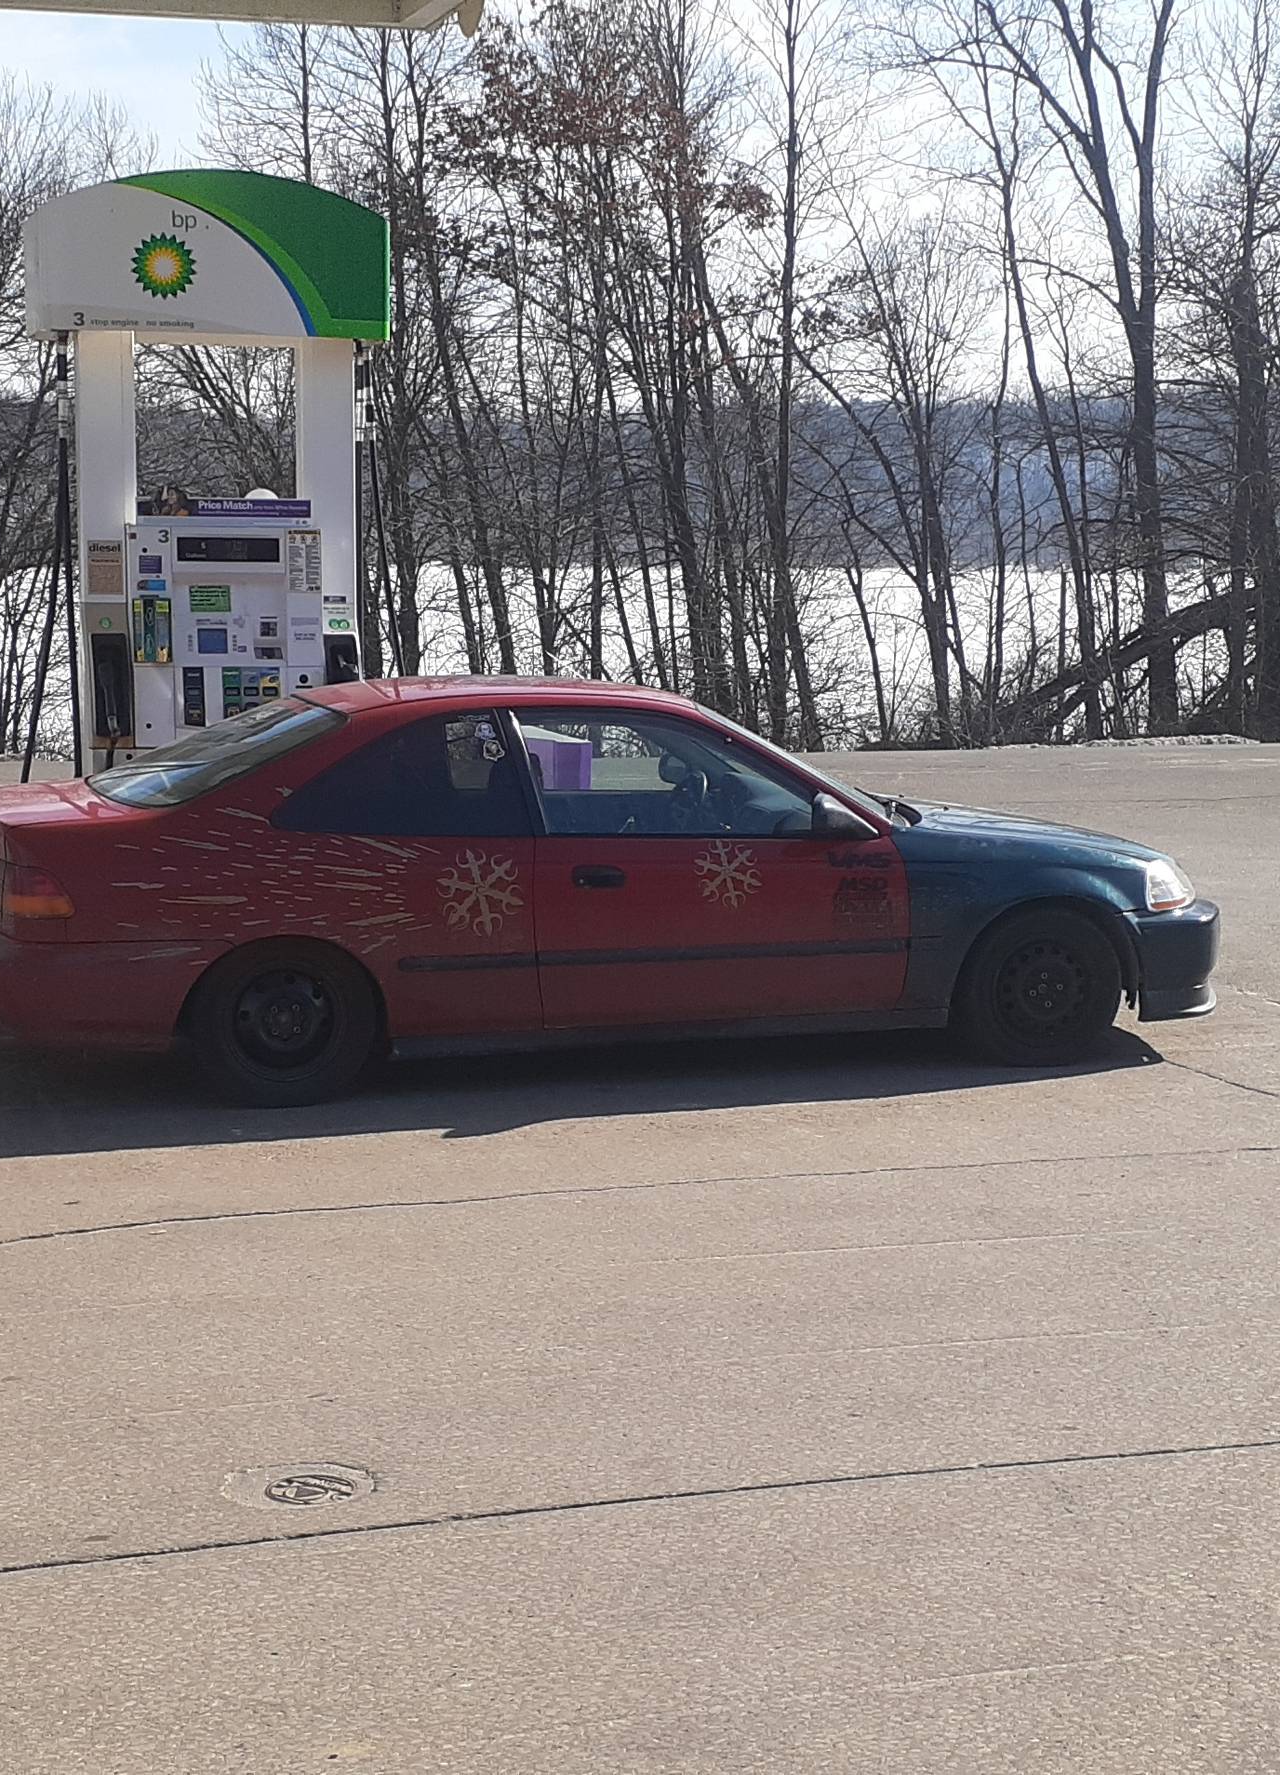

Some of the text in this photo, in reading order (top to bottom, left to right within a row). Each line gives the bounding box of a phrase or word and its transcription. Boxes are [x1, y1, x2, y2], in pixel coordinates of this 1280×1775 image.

[172, 210, 197, 232] bp
[73, 312, 85, 326] 3
[90, 319, 109, 327] stop
[198, 500, 221, 510] Price
[223, 500, 253, 510] Match
[158, 529, 169, 543] 3
[89, 543, 121, 552] diesel
